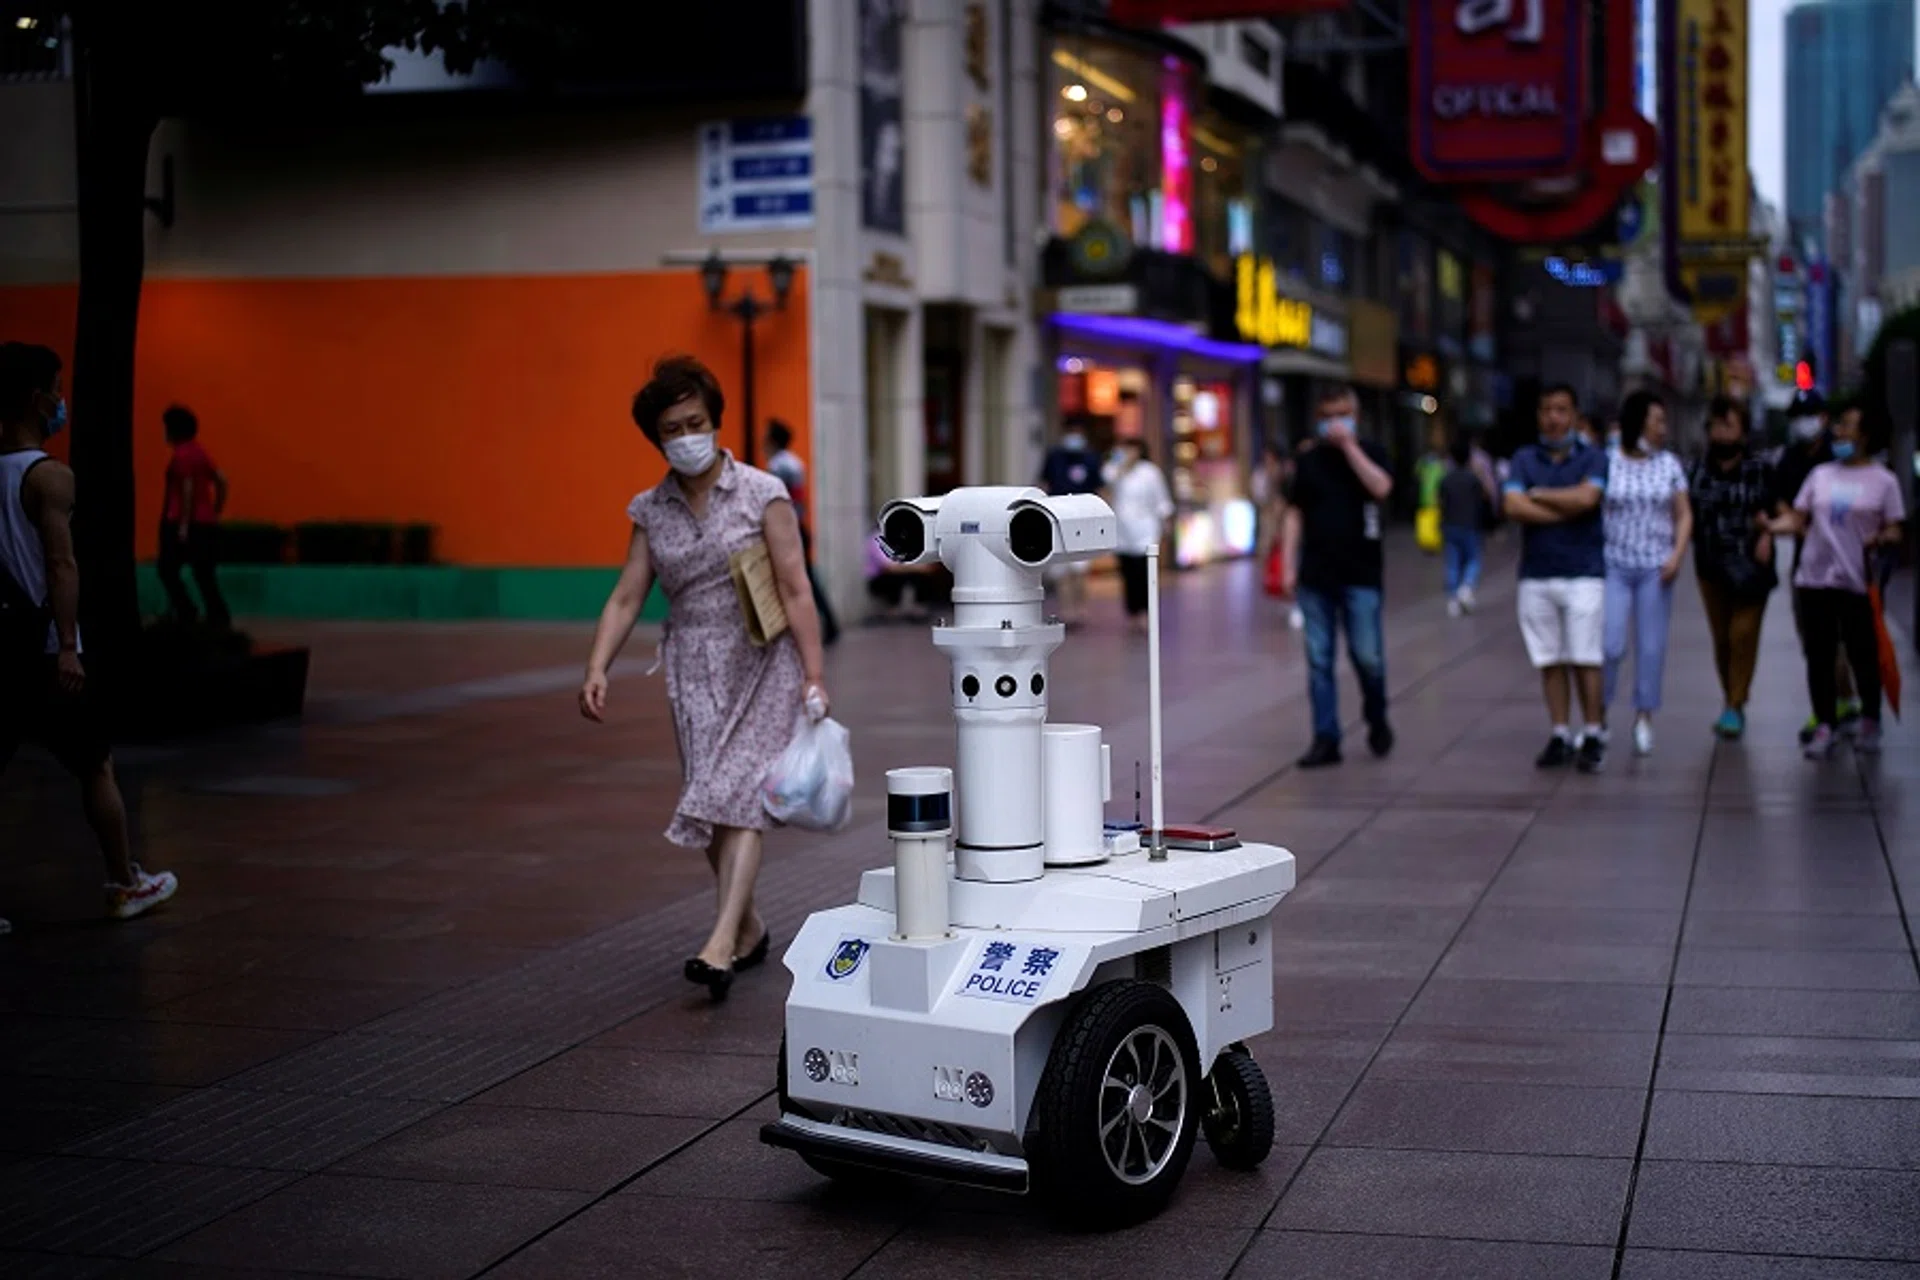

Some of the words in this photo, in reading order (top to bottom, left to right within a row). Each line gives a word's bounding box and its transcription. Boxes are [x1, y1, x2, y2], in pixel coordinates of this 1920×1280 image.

[1432, 83, 1559, 119] OPTICAL
[980, 941, 1059, 976] 警察
[966, 973, 1041, 998] POLICE
